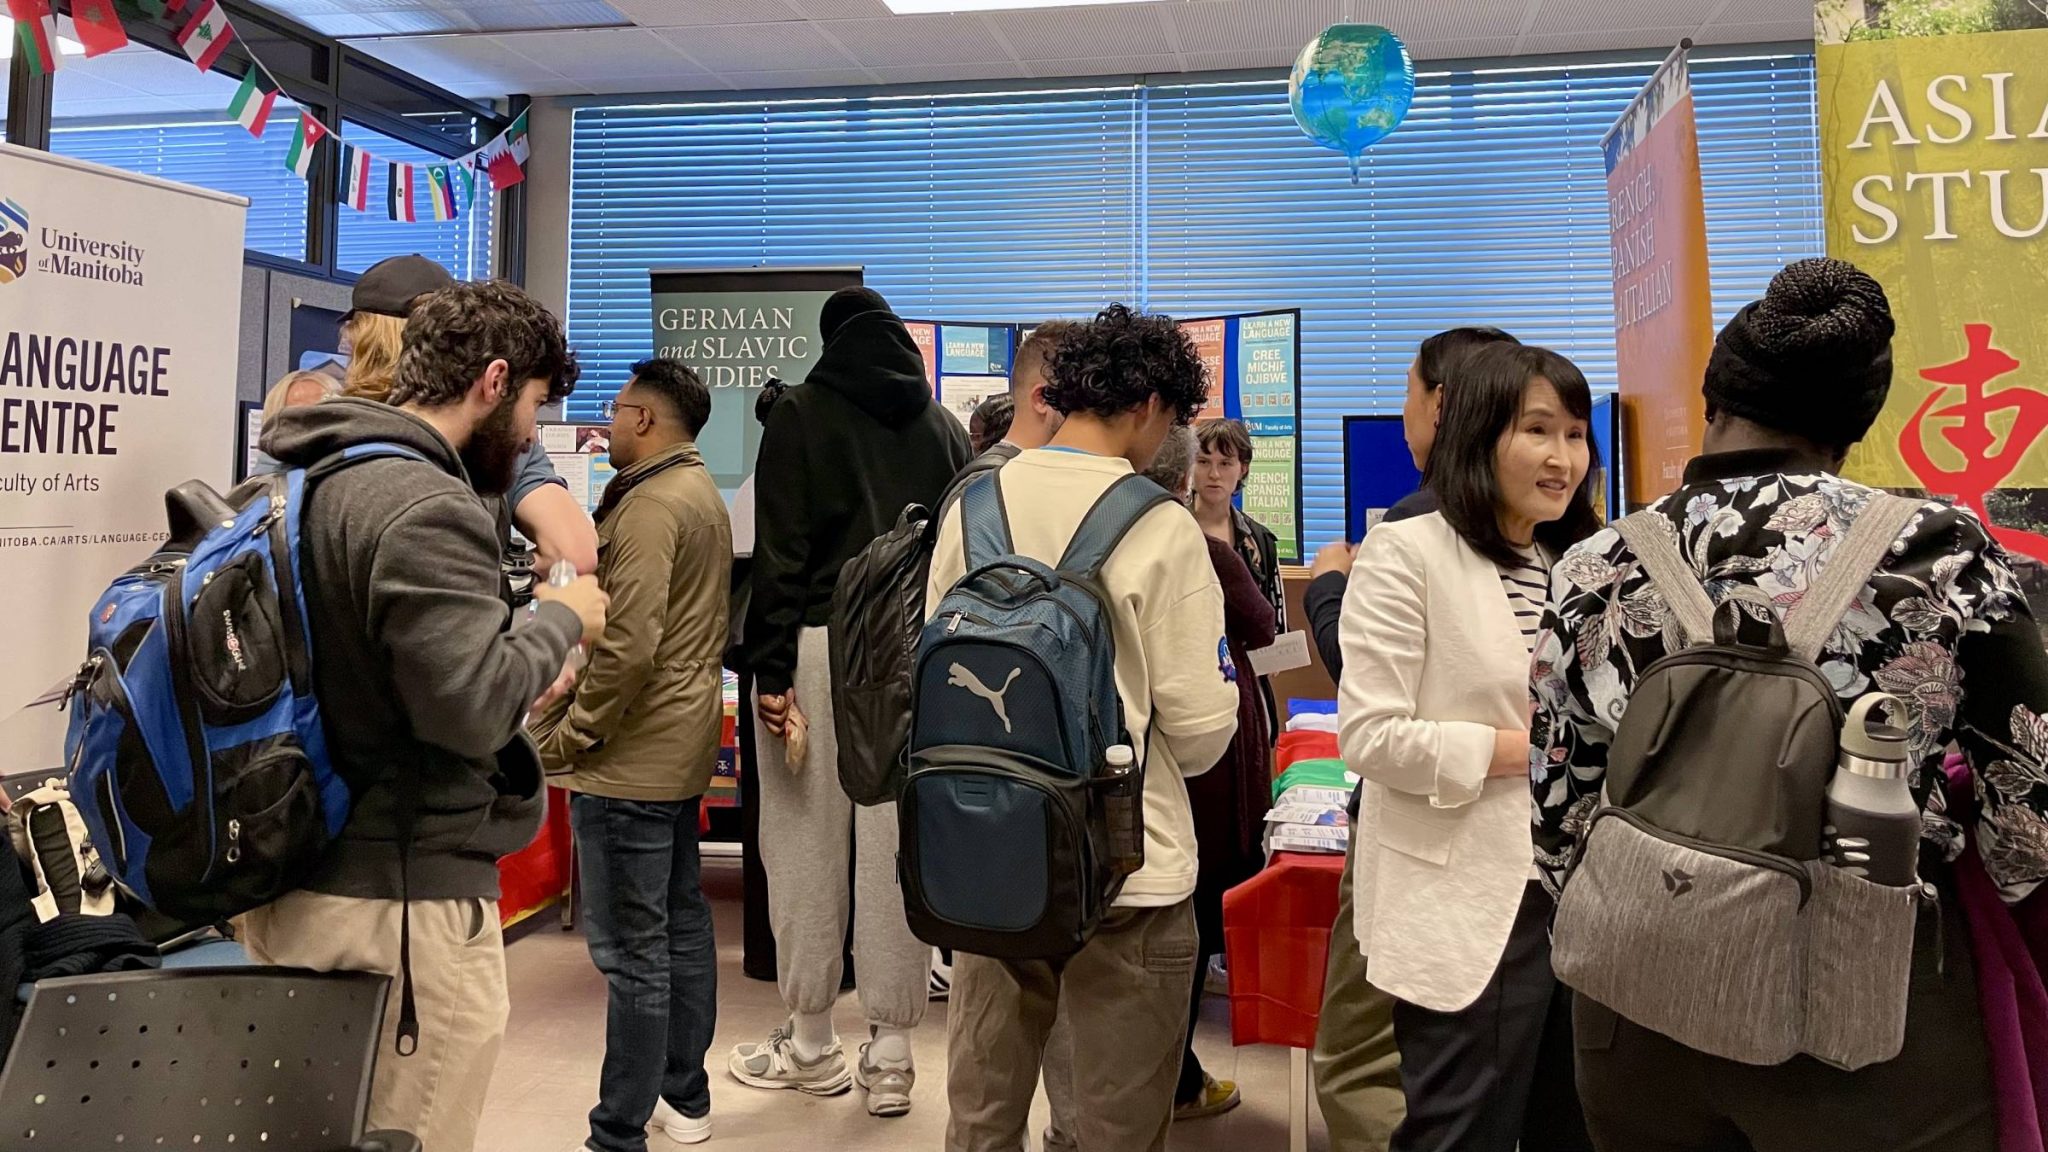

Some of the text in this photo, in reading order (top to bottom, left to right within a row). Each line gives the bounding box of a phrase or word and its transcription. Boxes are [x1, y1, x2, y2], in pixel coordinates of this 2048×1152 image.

[1851, 167, 2048, 244] STU
[41, 226, 145, 268] University
[38, 253, 144, 286] of Manitoba
[1624, 260, 1673, 326] ITALIAN
[659, 307, 794, 331] GERMAN
[1243, 327, 1291, 339] LANGUAGE
[659, 335, 808, 359] and SLAVIC
[1253, 349, 1281, 361] CREE
[0, 331, 171, 397] ANGUAGE
[1247, 361, 1286, 373] MICHIF
[1246, 372, 1288, 384] OJIBWE
[1, 398, 119, 455] ENTRE
[1252, 448, 1292, 459] ANGUAGE
[42, 472, 61, 492] of
[64, 472, 100, 492] Arts
[1248, 471, 1289, 484] FRENCH
[1246, 484, 1290, 496] SPANISH
[1249, 496, 1288, 508] ITALIAN
